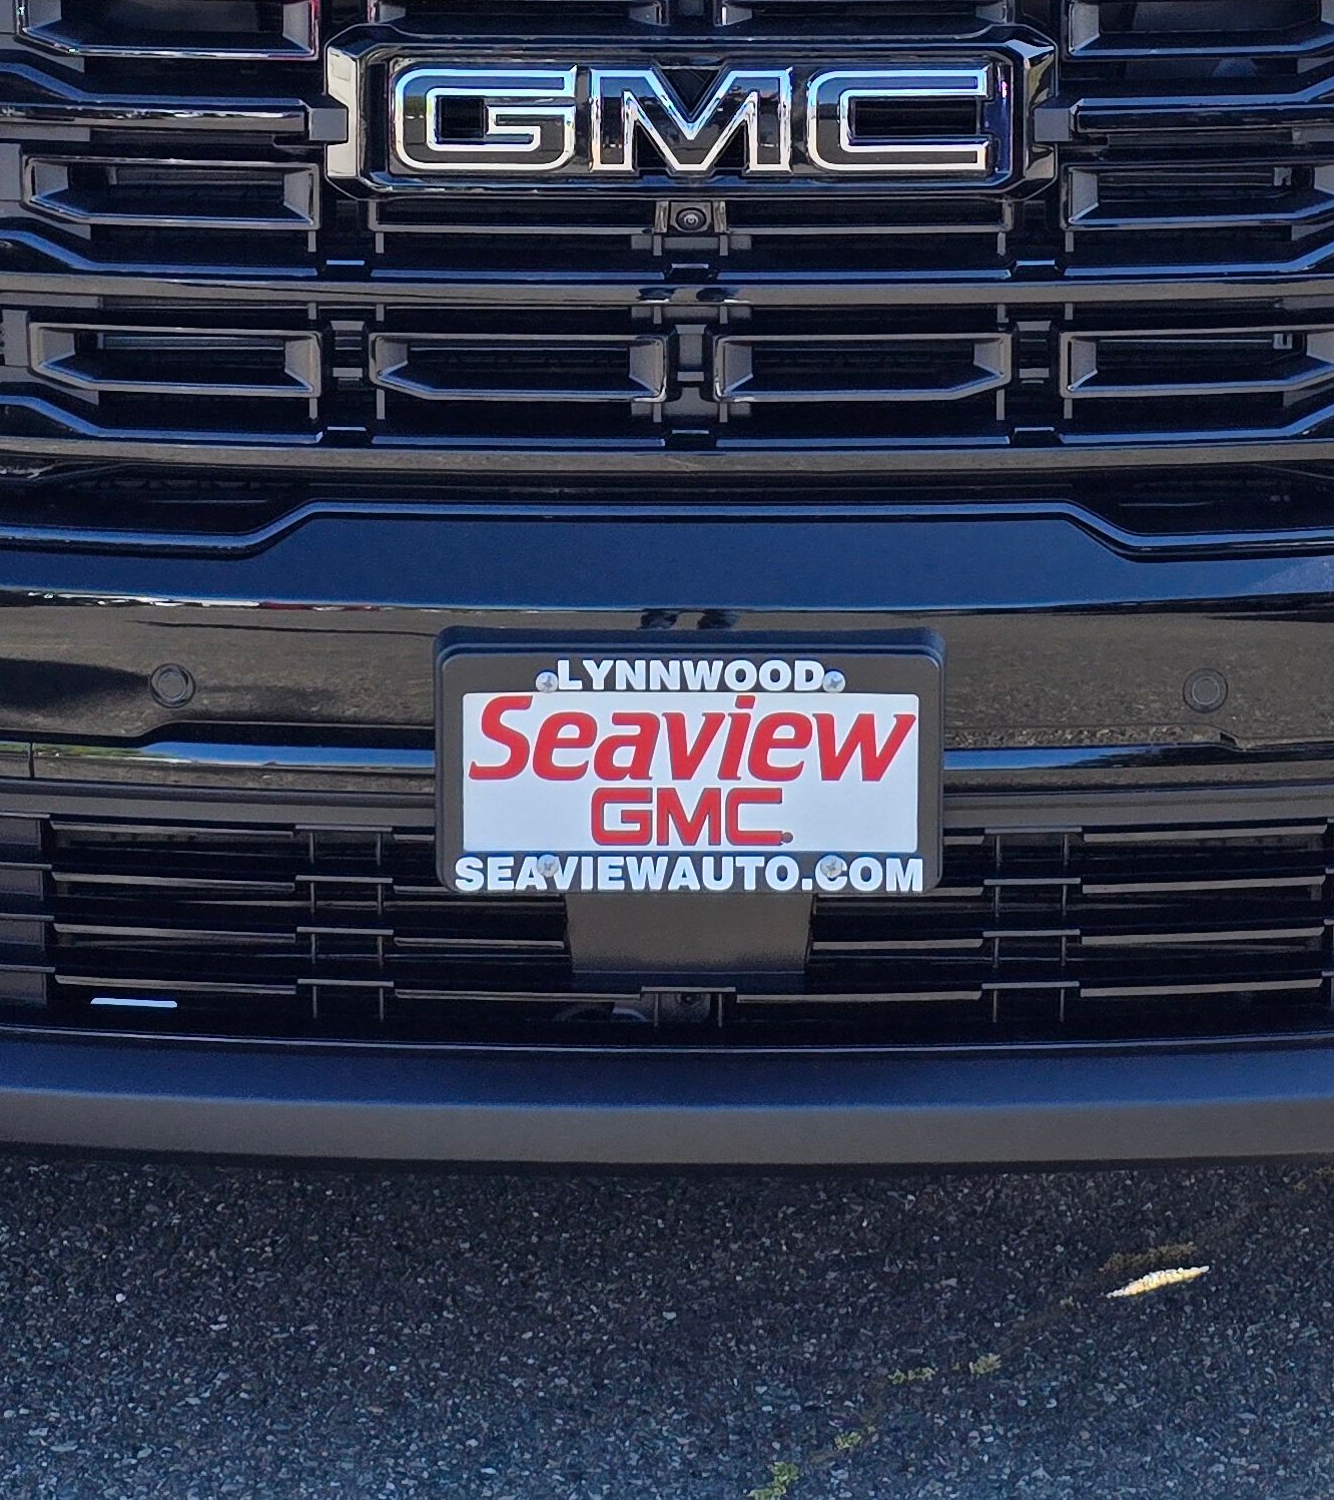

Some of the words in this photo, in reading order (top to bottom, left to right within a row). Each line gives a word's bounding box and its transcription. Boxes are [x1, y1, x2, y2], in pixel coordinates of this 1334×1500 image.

[394, 65, 988, 173] GMC
[557, 659, 825, 692] LYNNWOOD
[468, 694, 917, 782] Seaview
[590, 787, 784, 847] GMC
[455, 855, 924, 892] SEAVIEWAUTO.COM
